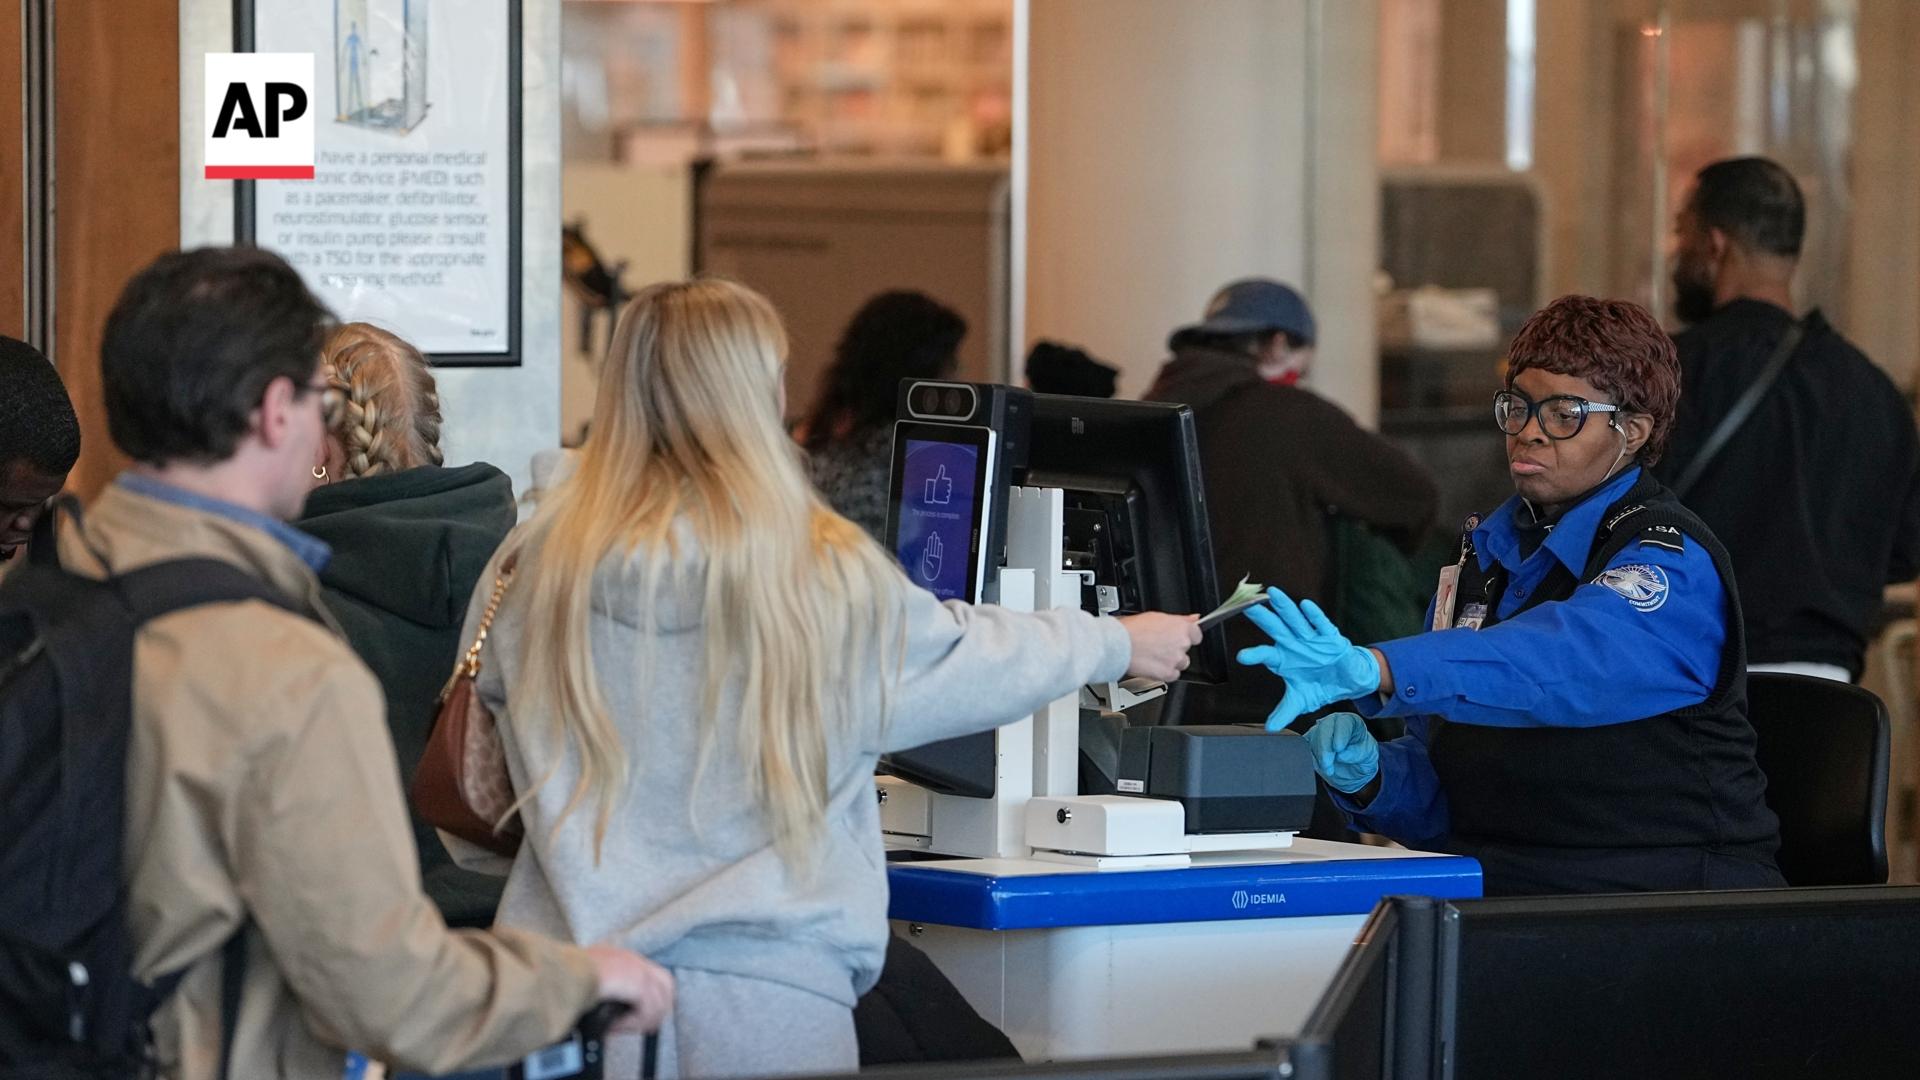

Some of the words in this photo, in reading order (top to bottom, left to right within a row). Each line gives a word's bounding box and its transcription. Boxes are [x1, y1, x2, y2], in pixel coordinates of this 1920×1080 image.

[321, 152, 355, 164] have
[359, 154, 368, 164] a
[371, 152, 428, 167] personal
[432, 152, 486, 165] medical
[350, 171, 394, 185] device
[455, 171, 484, 185] such
[285, 193, 299, 205] as
[303, 193, 311, 205] a
[389, 212, 438, 227] glucose
[278, 233, 292, 245] or
[297, 231, 342, 245] insulin
[346, 232, 385, 247] pump
[389, 231, 432, 247] please
[436, 232, 486, 245] consult
[313, 254, 321, 266] a
[327, 252, 352, 265] TSO
[356, 252, 374, 265] for
[379, 252, 400, 266] the
[1648, 525, 1680, 535] SA
[1250, 893, 1286, 904] IDEMIA
